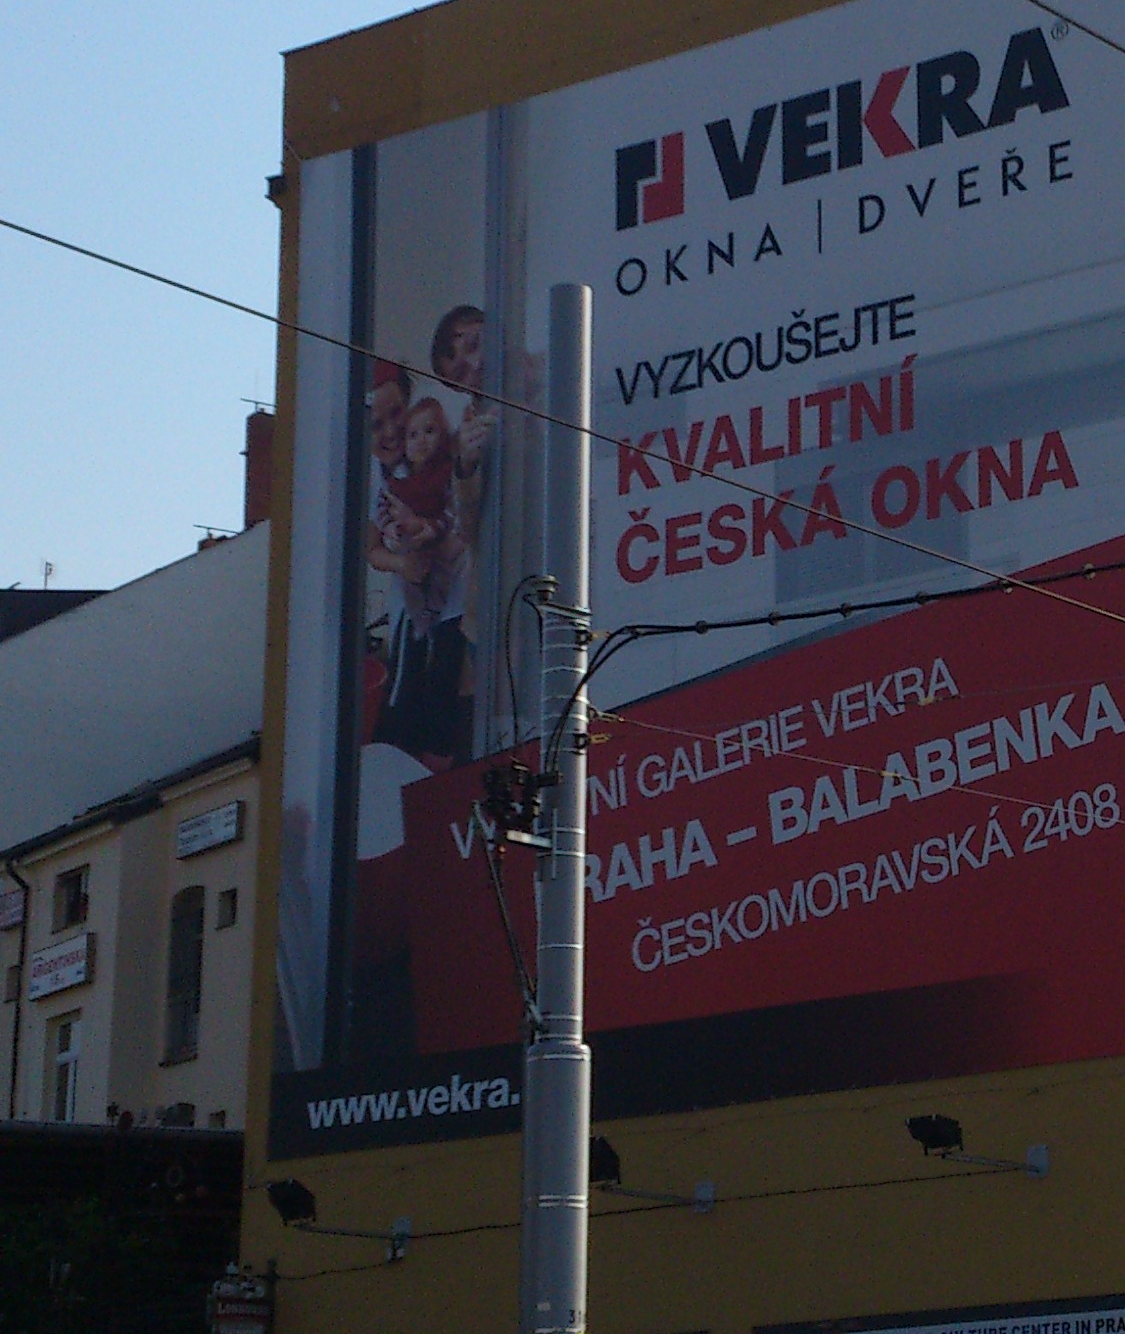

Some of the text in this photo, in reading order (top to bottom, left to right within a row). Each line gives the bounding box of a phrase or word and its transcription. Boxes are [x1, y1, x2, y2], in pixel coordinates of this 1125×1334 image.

[704, 26, 1069, 200] VEKRA
[615, 140, 1074, 297] OKNA DVEŘE
[615, 294, 916, 406] VYZKOUŠEJTE
[616, 353, 916, 496] KVALITNÍ
[615, 430, 1080, 584] ČESKÁ OKNA
[636, 713, 804, 799] GALERIE
[812, 657, 960, 740] VEKRA
[585, 817, 718, 905] RAHA
[631, 783, 1121, 973] ČESKOMORAVSKÁ 2408
